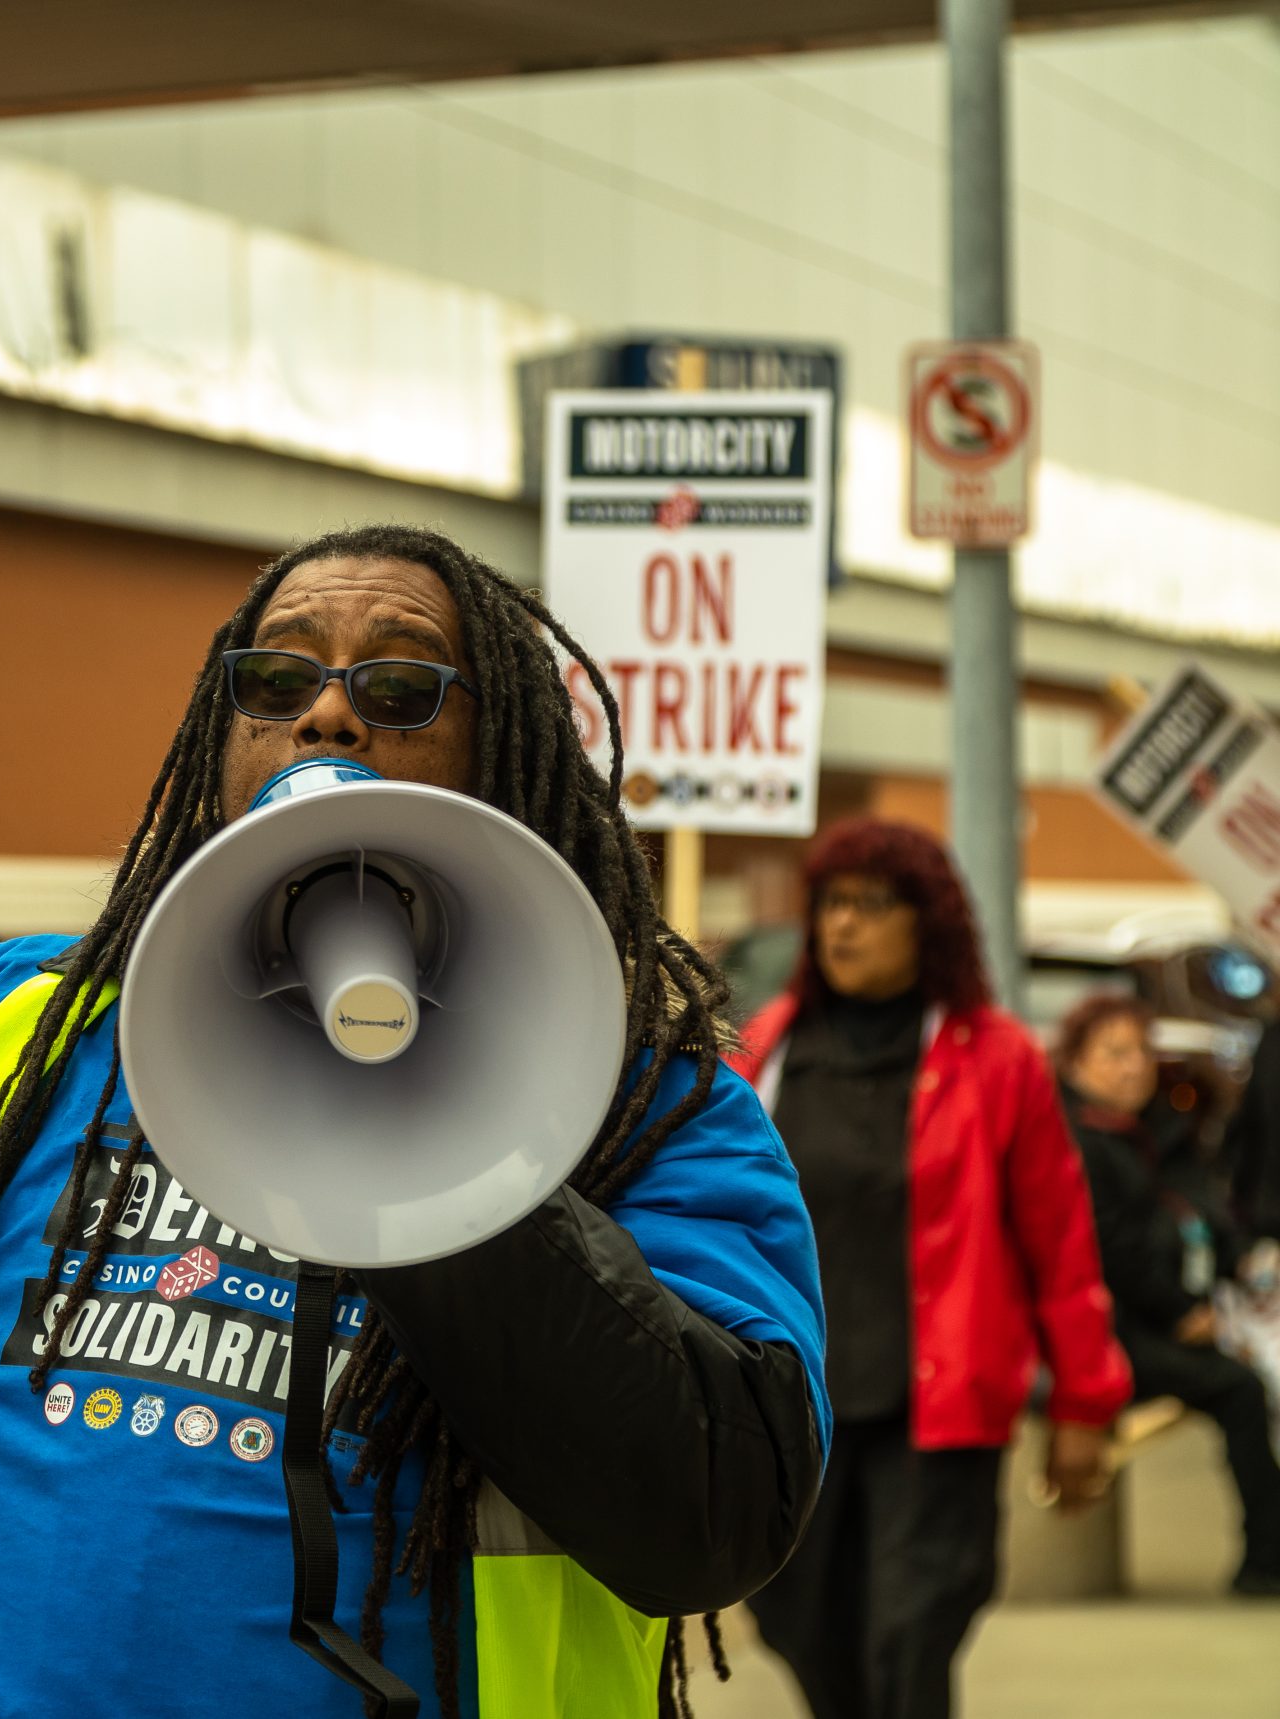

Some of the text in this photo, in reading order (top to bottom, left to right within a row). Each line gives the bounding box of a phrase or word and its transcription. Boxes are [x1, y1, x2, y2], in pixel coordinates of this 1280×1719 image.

[583, 417, 796, 474] MOTORCITY
[642, 553, 735, 646] ON
[566, 660, 807, 755] STRIKE
[63, 1260, 362, 1328] CSINO COUIL
[47, 1403, 69, 1414] HERE!
[48, 1394, 72, 1405] UNITE
[93, 1403, 111, 1414] UAW
